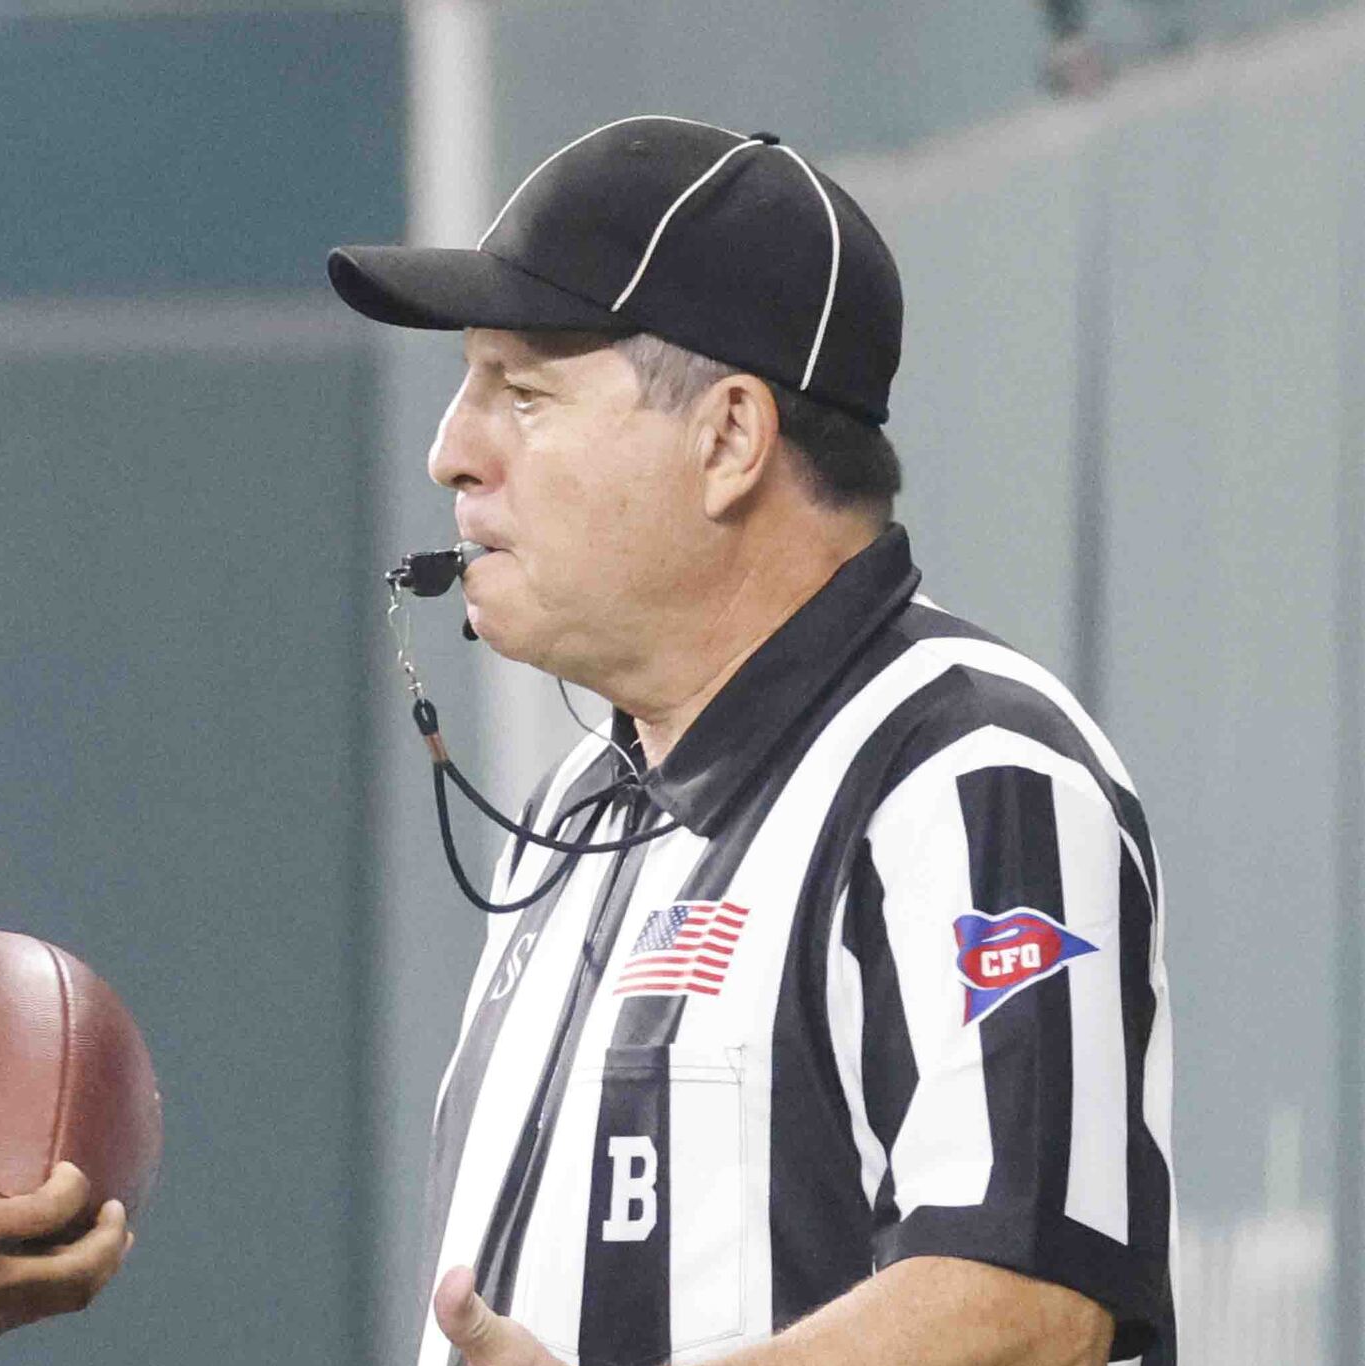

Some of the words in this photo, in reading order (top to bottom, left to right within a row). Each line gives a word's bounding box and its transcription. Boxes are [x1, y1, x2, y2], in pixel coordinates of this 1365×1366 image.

[488, 931, 538, 1002] S
[980, 943, 1042, 977] CFO
[602, 1136, 658, 1242] B
